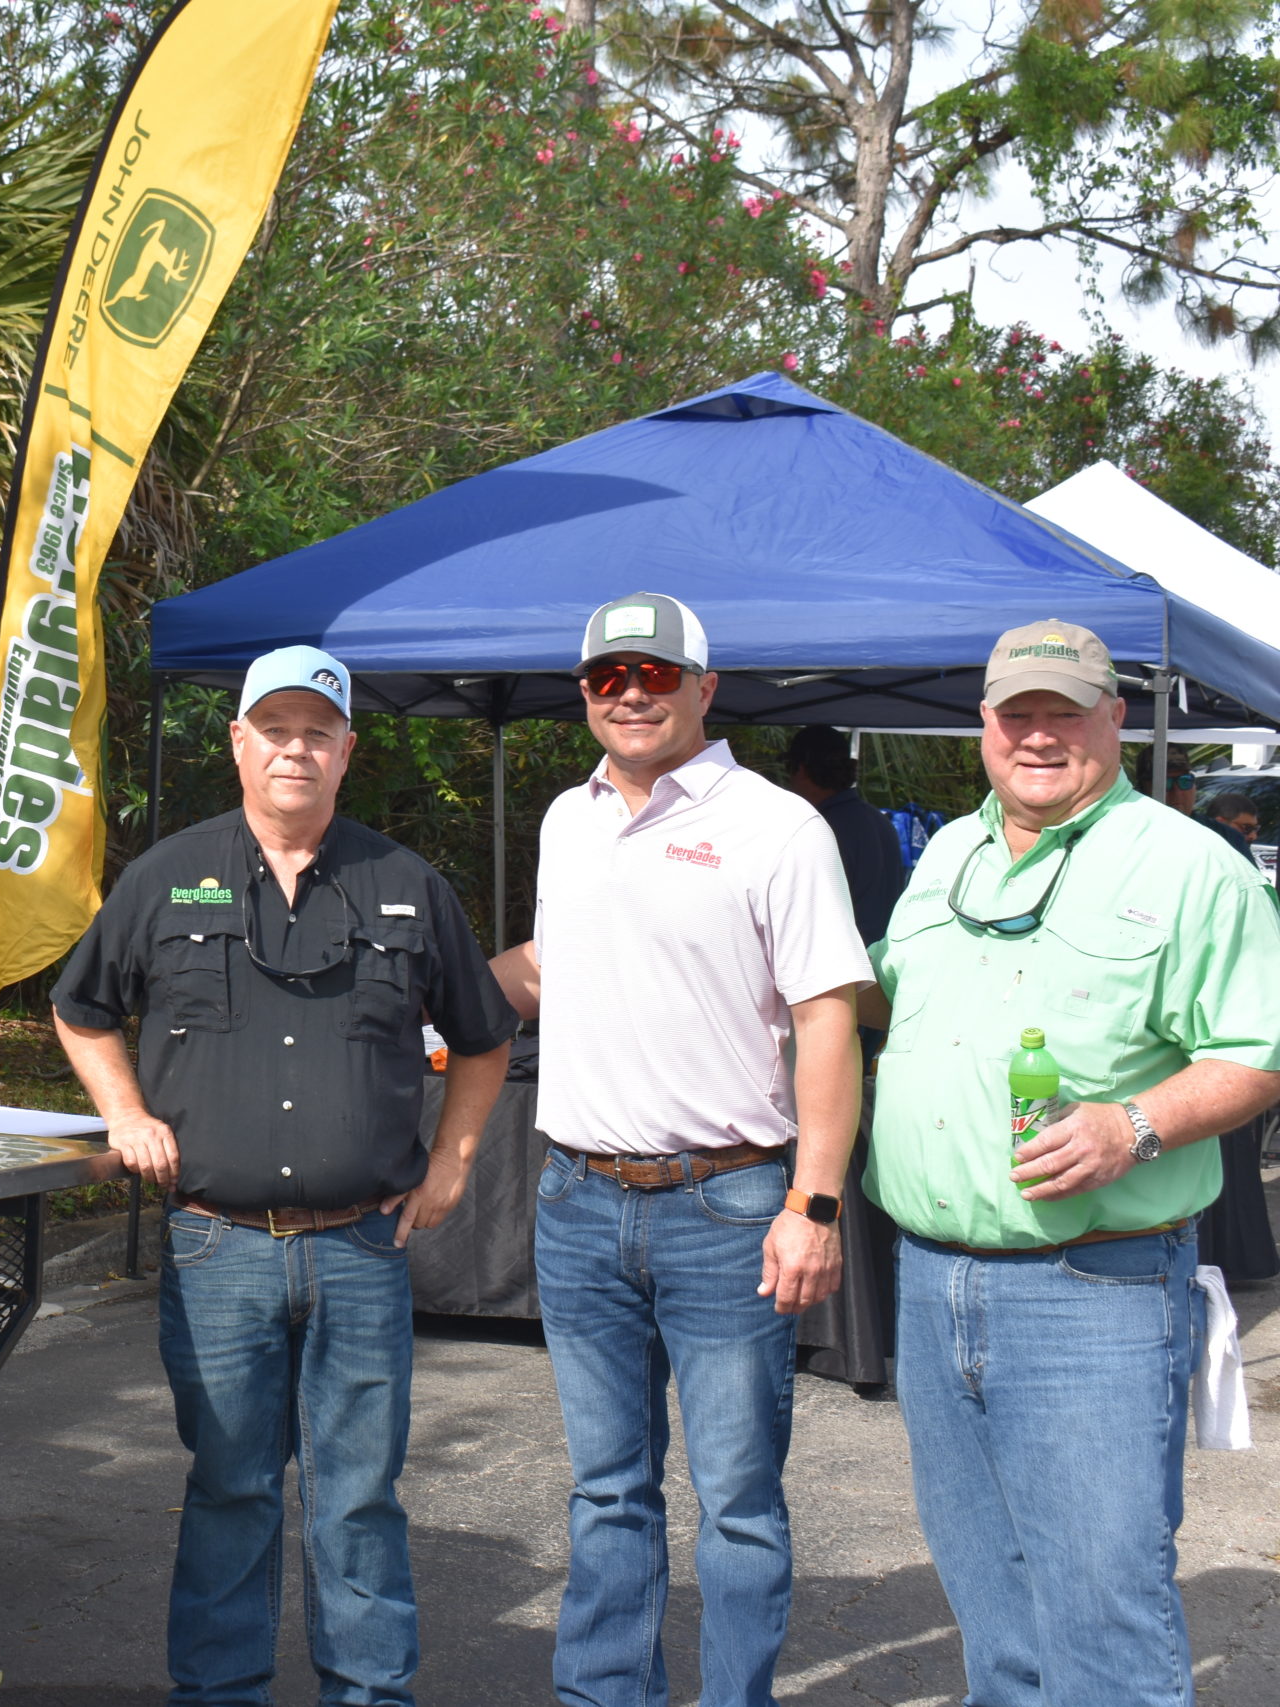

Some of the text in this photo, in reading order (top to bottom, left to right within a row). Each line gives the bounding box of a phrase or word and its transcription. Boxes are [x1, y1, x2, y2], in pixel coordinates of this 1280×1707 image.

[63, 109, 150, 370] JOHN DEERE
[36, 458, 73, 576] Since 1963
[1008, 643, 1080, 659] Everglades
[665, 843, 723, 866] Everglades
[171, 887, 232, 901] Everglades
